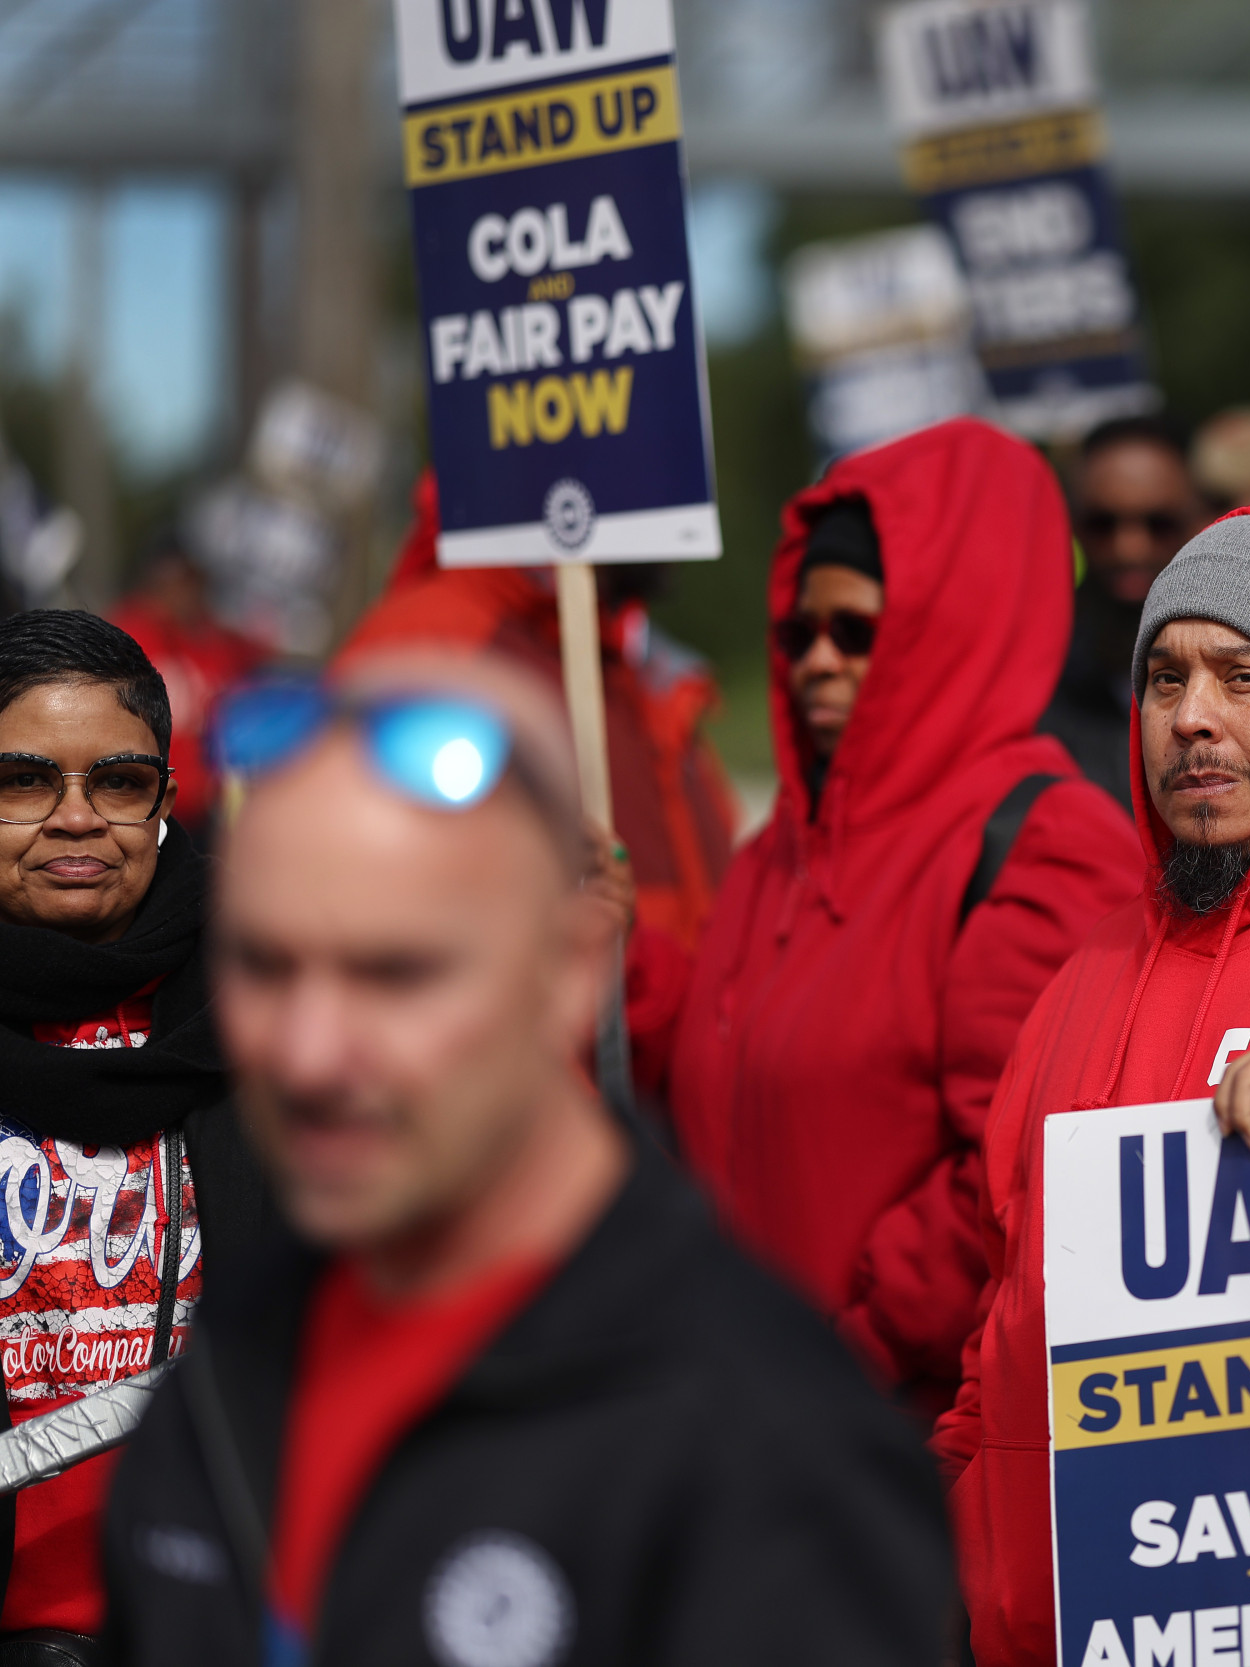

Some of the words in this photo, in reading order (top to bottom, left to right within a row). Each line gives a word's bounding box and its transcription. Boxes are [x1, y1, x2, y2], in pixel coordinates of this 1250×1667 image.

[420, 100, 577, 171] STAND
[593, 84, 658, 140] UP
[467, 195, 633, 283] COLA
[430, 301, 564, 384] FAIR
[567, 281, 685, 364] PAY
[488, 365, 633, 449] NOW
